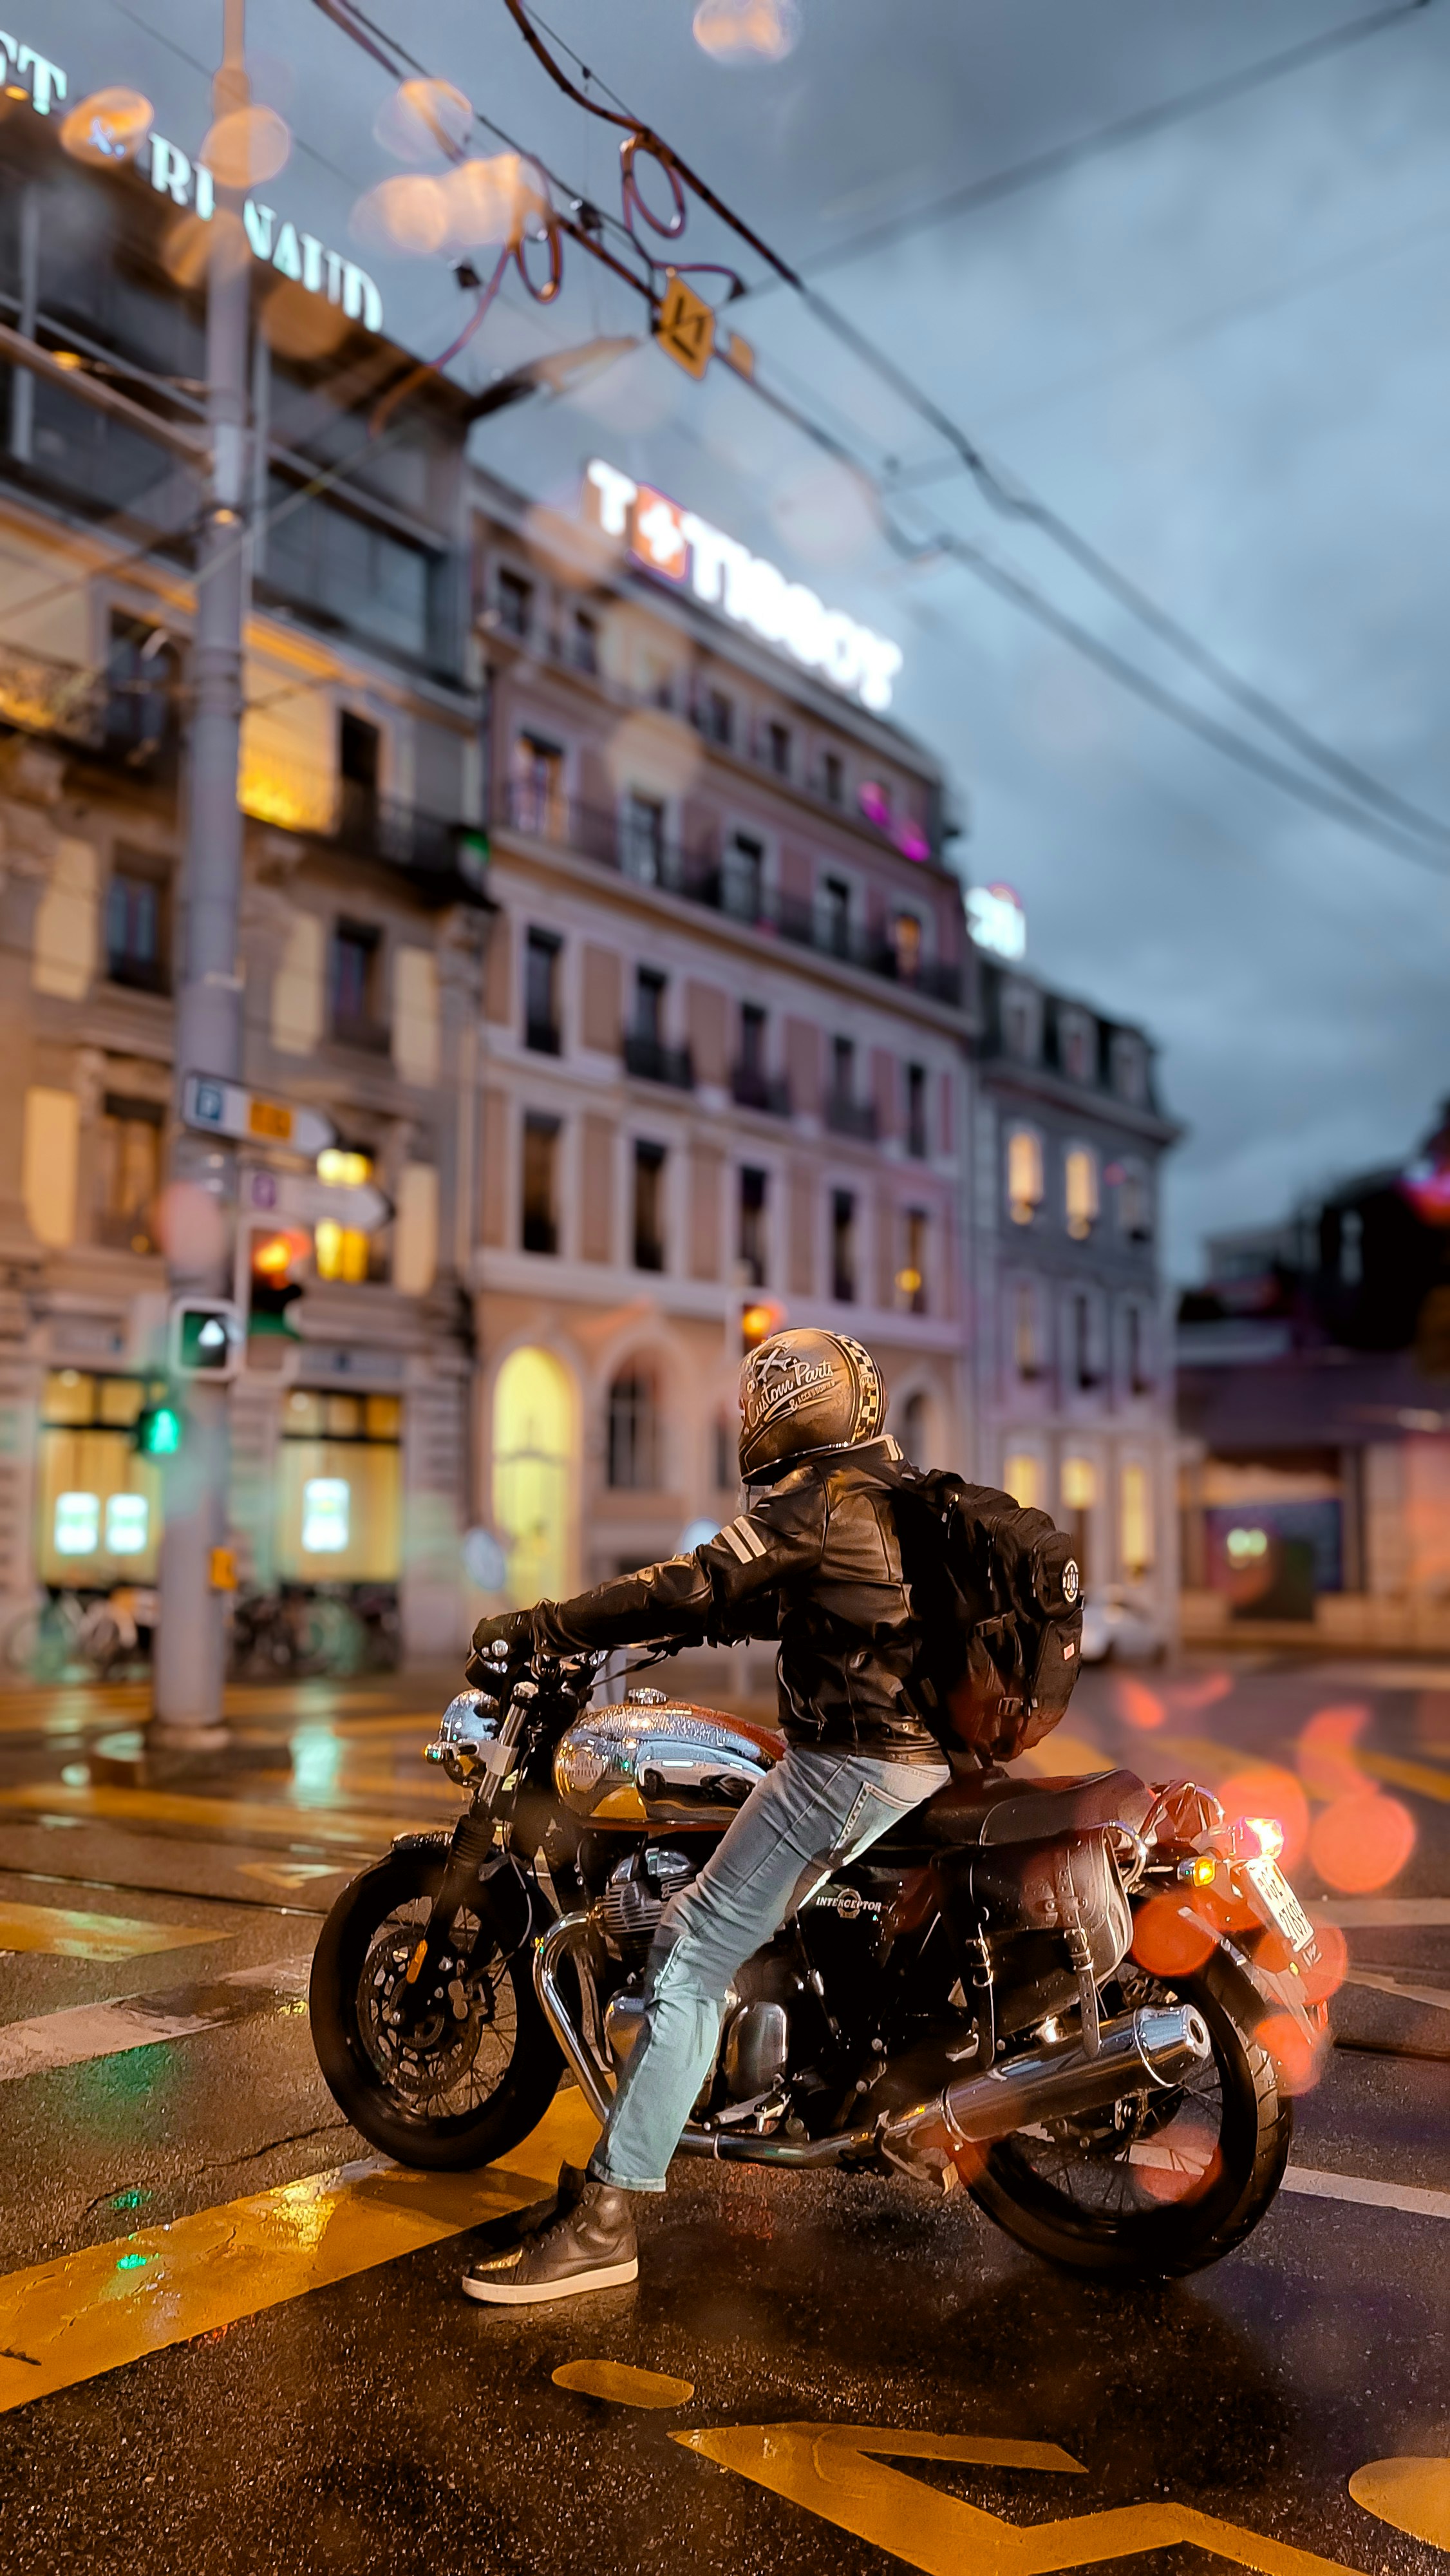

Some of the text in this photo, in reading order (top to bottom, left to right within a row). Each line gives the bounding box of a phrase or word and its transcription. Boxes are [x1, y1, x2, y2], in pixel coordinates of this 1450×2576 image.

[748, 1358, 834, 1428] Custom Parts
[816, 1896, 882, 1913] INTERCEPTOR
